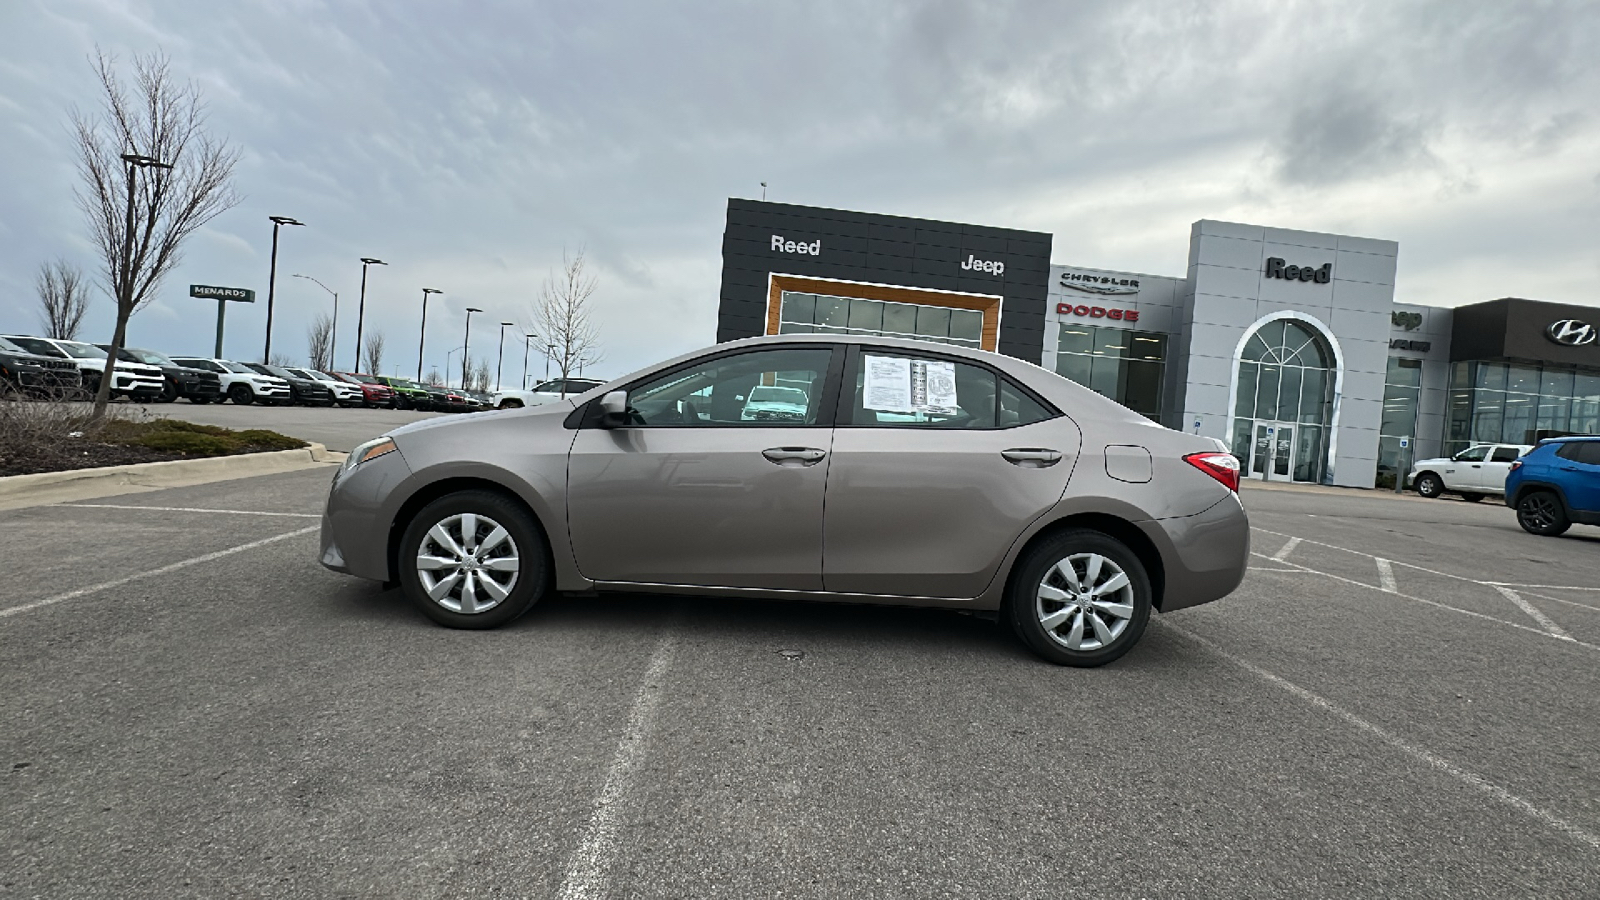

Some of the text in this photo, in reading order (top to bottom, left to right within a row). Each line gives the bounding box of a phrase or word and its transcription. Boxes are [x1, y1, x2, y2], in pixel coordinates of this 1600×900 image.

[771, 235, 821, 256] Reed
[960, 254, 1004, 275] Jeep
[1266, 256, 1332, 284] Reed
[1061, 273, 1140, 287] CHRYSLER
[194, 286, 246, 298] MENARDS
[1057, 302, 1140, 321] DODGE
[1391, 311, 1423, 332] ep
[1388, 338, 1431, 353] AM
